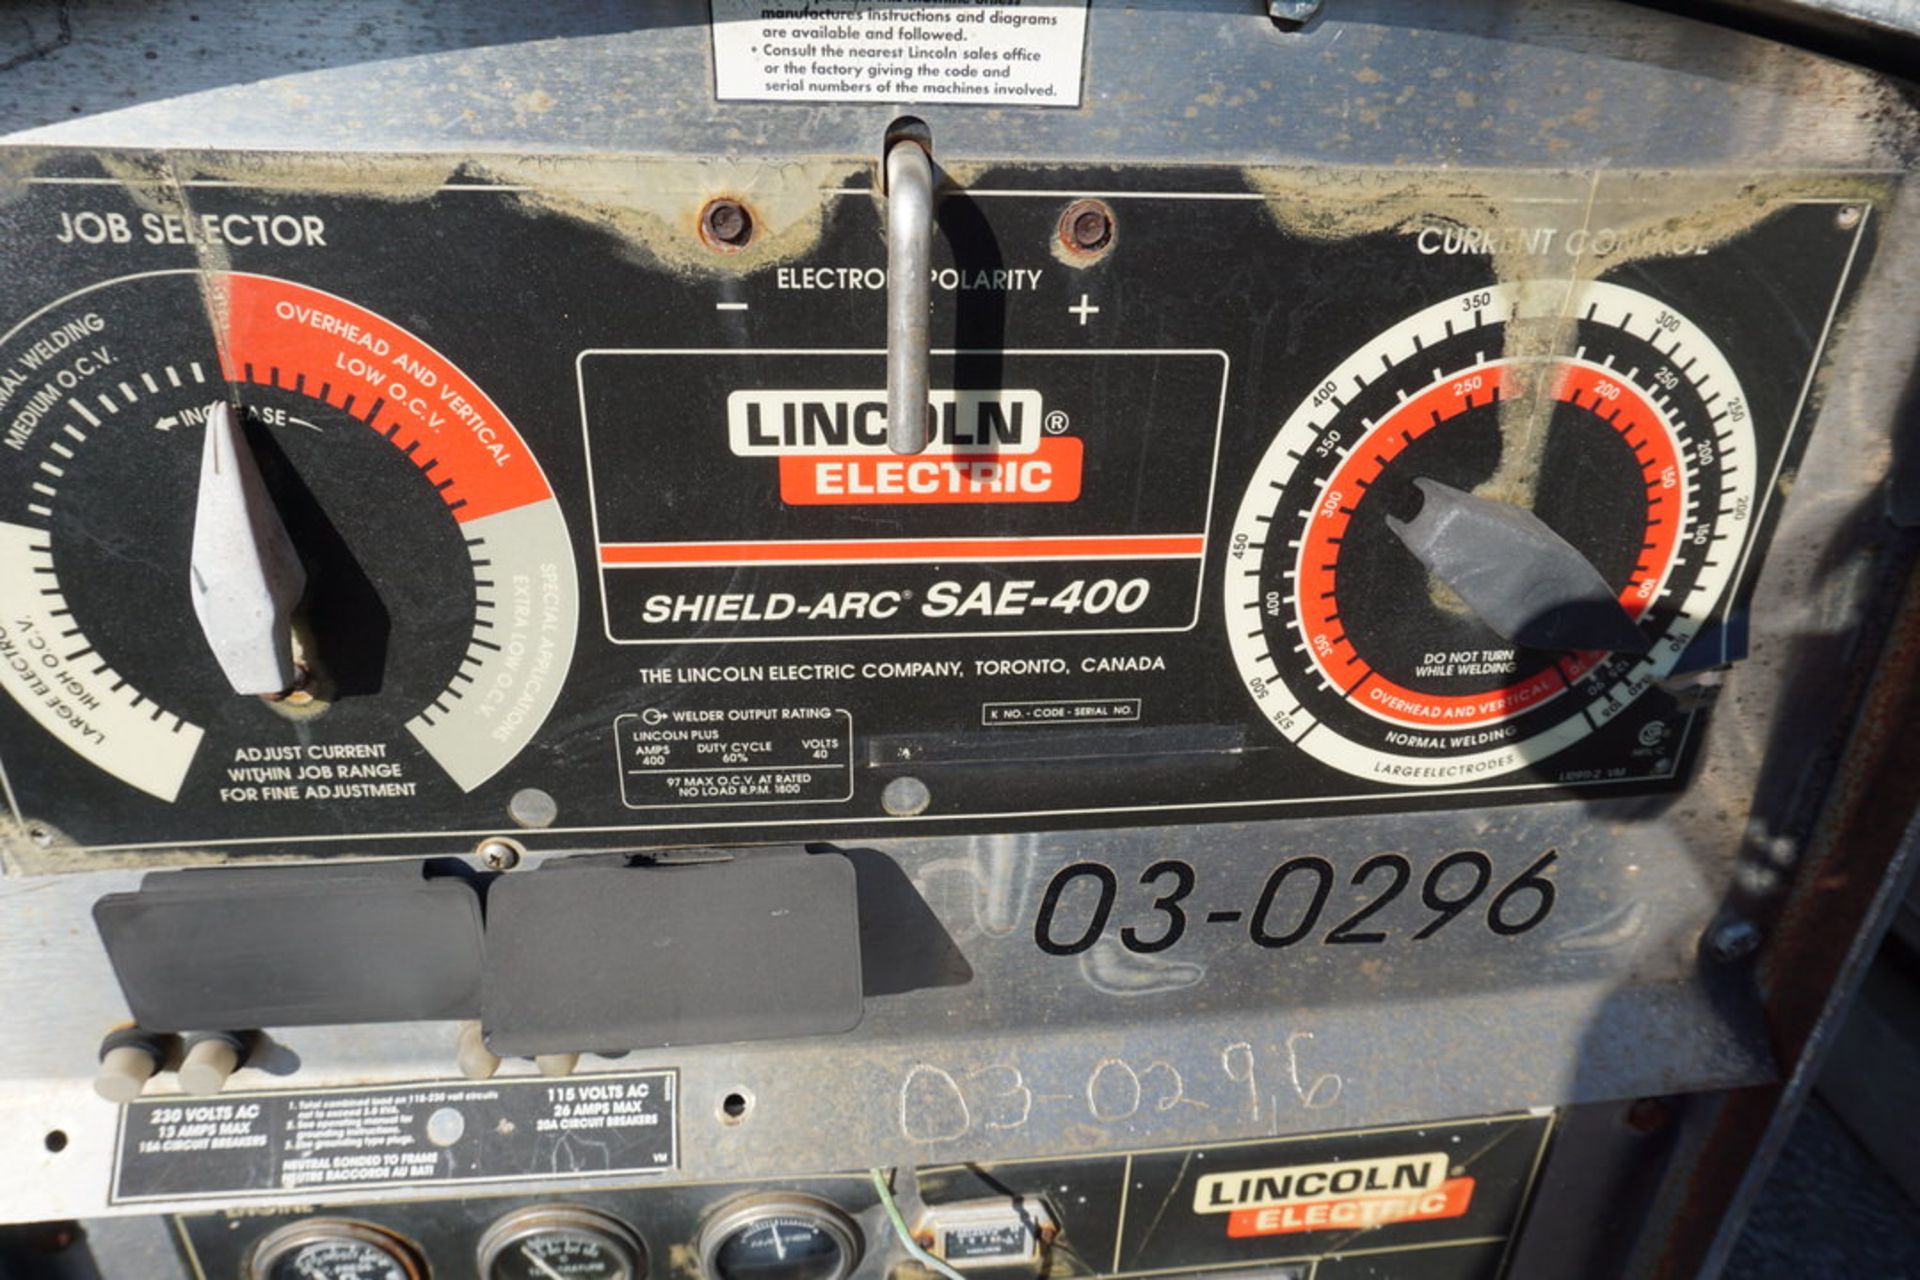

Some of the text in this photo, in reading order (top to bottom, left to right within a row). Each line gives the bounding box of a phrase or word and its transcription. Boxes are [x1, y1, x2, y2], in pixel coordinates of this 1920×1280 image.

[868, 8, 951, 22] instructions
[956, 11, 985, 23] and
[989, 11, 1058, 28] diagrams
[762, 25, 968, 42] are available and followed.
[763, 43, 1041, 62] Consult the nearest Lincoln sales office
[764, 61, 1011, 79] or the factory giving the code and
[765, 79, 1057, 97] serial numbers of the machines involved.
[57, 211, 327, 247] JOB SELECTOR
[777, 267, 888, 290] ELECTRO
[1462, 292, 1492, 312] 350
[1655, 310, 1681, 332] 300
[18, 313, 105, 370] WELDING
[275, 301, 511, 468] OVERHEAD AND VERTICAL
[1453, 375, 1482, 396] 250
[1654, 366, 1680, 390] 250
[4, 345, 119, 451] MEDIUM O.C.V.
[335, 351, 446, 434] LOW O.C.V.
[1312, 380, 1338, 409] 400
[1593, 379, 1621, 400] 200
[1727, 396, 1746, 423] 250
[746, 401, 1024, 447] LINCLN
[1316, 429, 1342, 458] 350
[1697, 440, 1714, 465] 200
[815, 460, 1053, 496] ELECTRIC
[1661, 465, 1677, 489] 150
[1320, 491, 1343, 518] 300
[1734, 495, 1749, 520] 200
[1693, 523, 1710, 545] 150
[1232, 533, 1249, 560] 450
[921, 578, 1151, 618] SAE-400
[1636, 578, 1656, 599] 100
[1266, 591, 1279, 616] 400
[507, 574, 531, 673] EXTRA LOW
[491, 562, 560, 744] SPECIAL APPLICATIONS
[1313, 634, 1333, 657] 350
[1669, 632, 1691, 653] 150
[16, 614, 100, 711] HIGH O.C.V.
[1424, 650, 1515, 665] DO NOT TURN
[640, 656, 1166, 684] THE LINCOLN ELECTRIC COMPANY, TORONTO, CANADA
[1415, 662, 1516, 677] WHILE WELDING
[1250, 676, 1270, 700] 500
[1370, 682, 1549, 718] OVERHEAD AND VERTICAL
[46, 696, 106, 745] LARGE
[672, 707, 832, 722] WELDER OUTPUT RATING
[991, 710, 998, 719] K
[1033, 708, 1065, 718] CODE
[1074, 706, 1108, 717] SERIAL
[1272, 710, 1295, 730] 575
[632, 730, 720, 741] LINCOLN PLUS
[1384, 725, 1517, 749] NORMAL WELDING
[235, 743, 387, 762] ADJUST CURRENT
[635, 738, 839, 756] AMPS DUTY CYCLE VOLTS
[642, 749, 829, 766] 400 60% 40
[227, 763, 403, 783] WITHIN JOB RANGE
[666, 773, 812, 787] 97 MAX O.C.V. AT RATED
[219, 782, 417, 802] FOR FINE ADJUSTMENT
[679, 786, 699, 796] NO
[701, 785, 737, 795] LOAD
[774, 783, 801, 793] 1800
[1033, 848, 1559, 957] 03-0296
[547, 1088, 576, 1102] 115
[578, 1085, 624, 1100] VOLTS
[626, 1084, 649, 1098] AC
[150, 1104, 260, 1124] 230 VOLTS AC
[553, 1100, 643, 1117] 26 AMPS MAX
[177, 1121, 252, 1138] AMPS MAX
[559, 1113, 658, 1129] CIRCUIT BREAKERS
[162, 1138, 210, 1152] CIRCUIT
[383, 1154, 399, 1166] TO
[401, 1151, 439, 1164] FRAME
[391, 1166, 408, 1178] AU
[1209, 1161, 1433, 1207] LINCOLN
